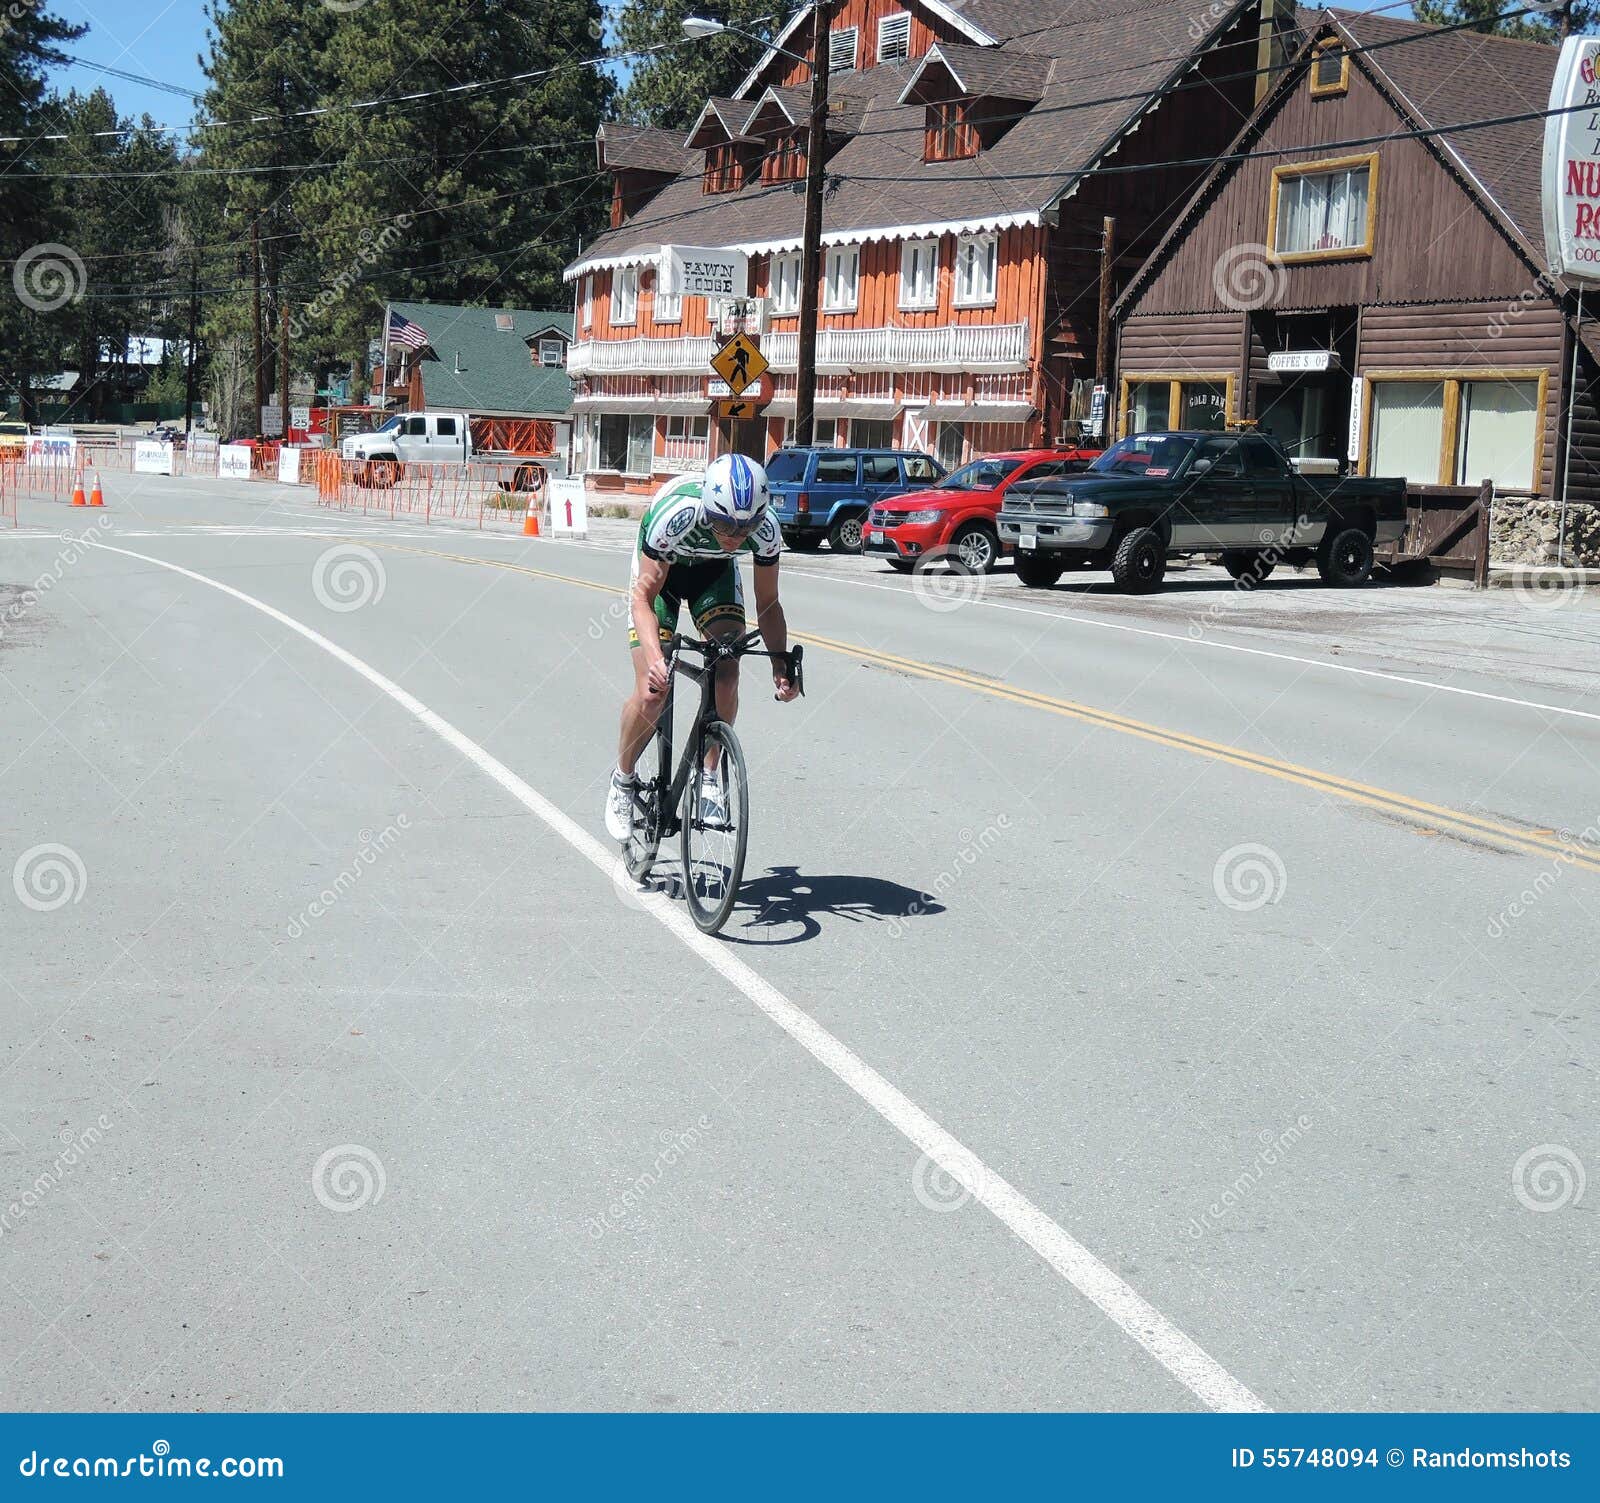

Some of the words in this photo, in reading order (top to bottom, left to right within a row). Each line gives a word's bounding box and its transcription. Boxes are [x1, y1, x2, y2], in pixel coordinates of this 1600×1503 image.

[683, 261, 735, 278] FAWN
[684, 277, 733, 293] LODGE
[1270, 355, 1300, 368] COFFEE
[1304, 355, 1328, 367] SOP
[1189, 394, 1208, 408] GOLD
[293, 418, 308, 427] 25
[1351, 383, 1359, 457] CLOSED
